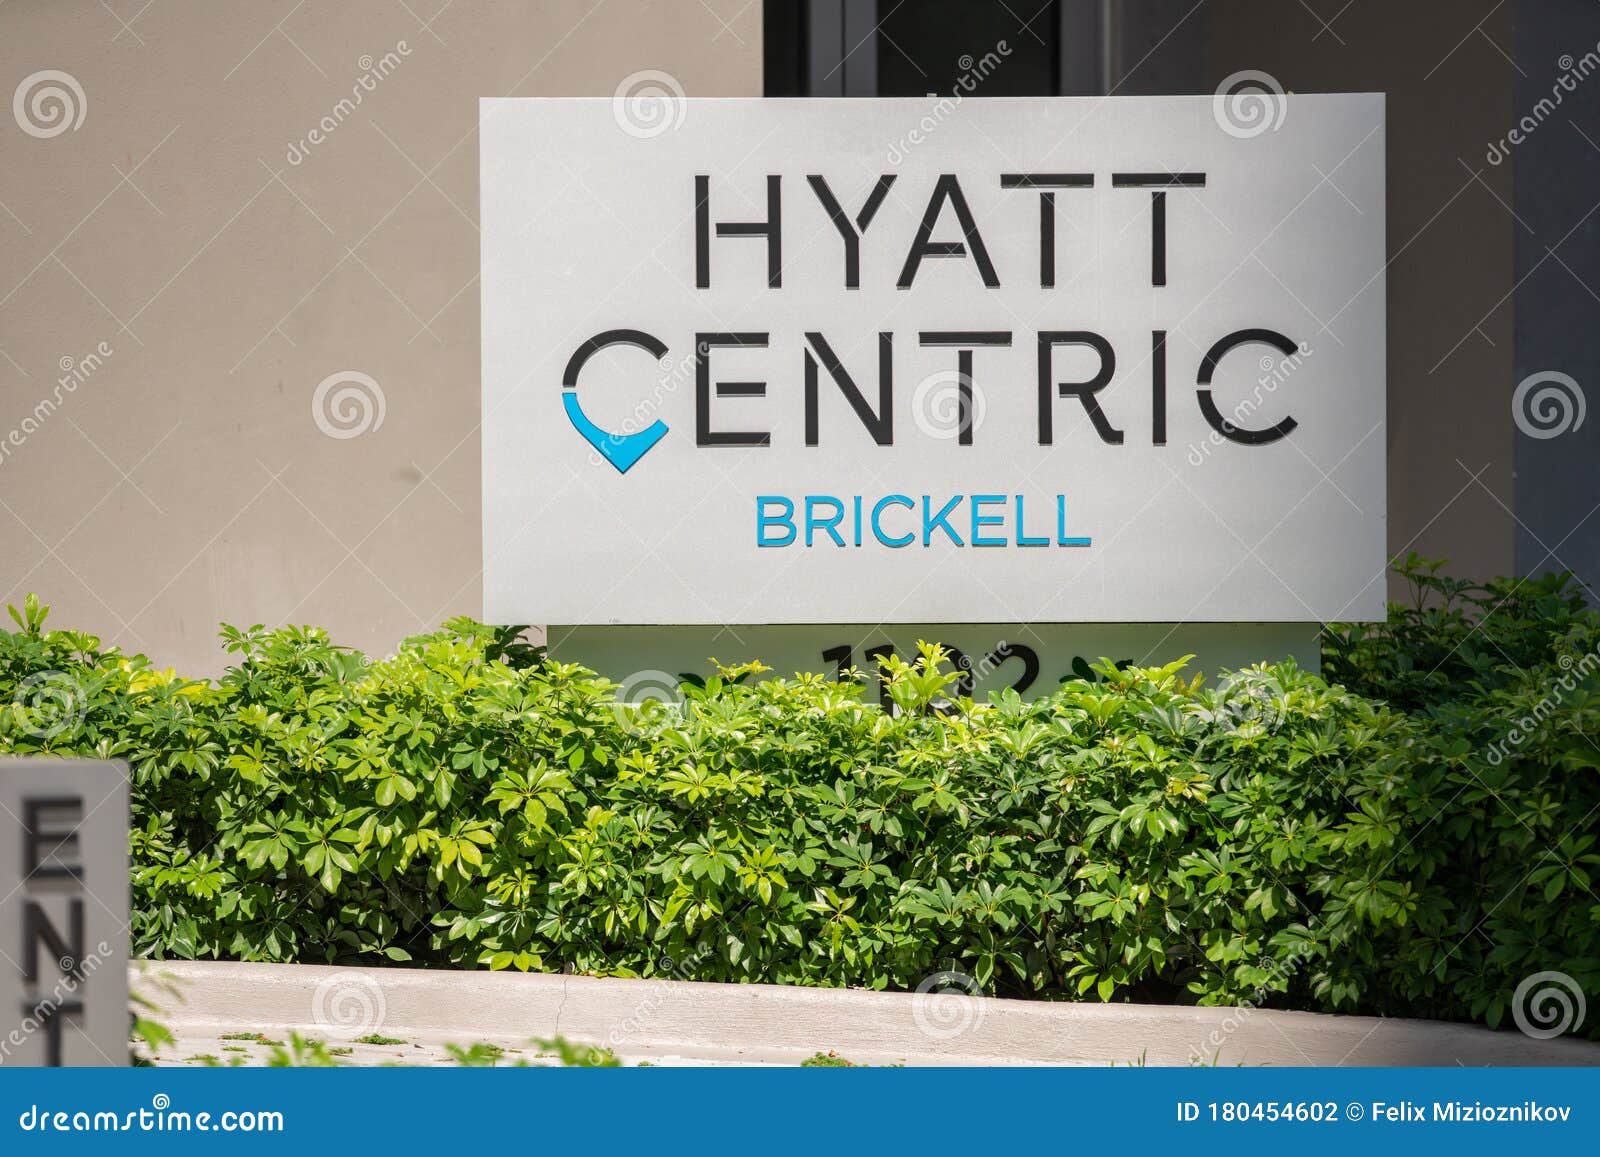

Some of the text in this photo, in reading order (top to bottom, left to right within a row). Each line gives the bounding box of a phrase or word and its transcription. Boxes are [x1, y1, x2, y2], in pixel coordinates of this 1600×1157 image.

[694, 172, 1206, 290] HYATT
[562, 328, 1299, 474] CENTRIC
[756, 494, 1092, 548] BRICKELL
